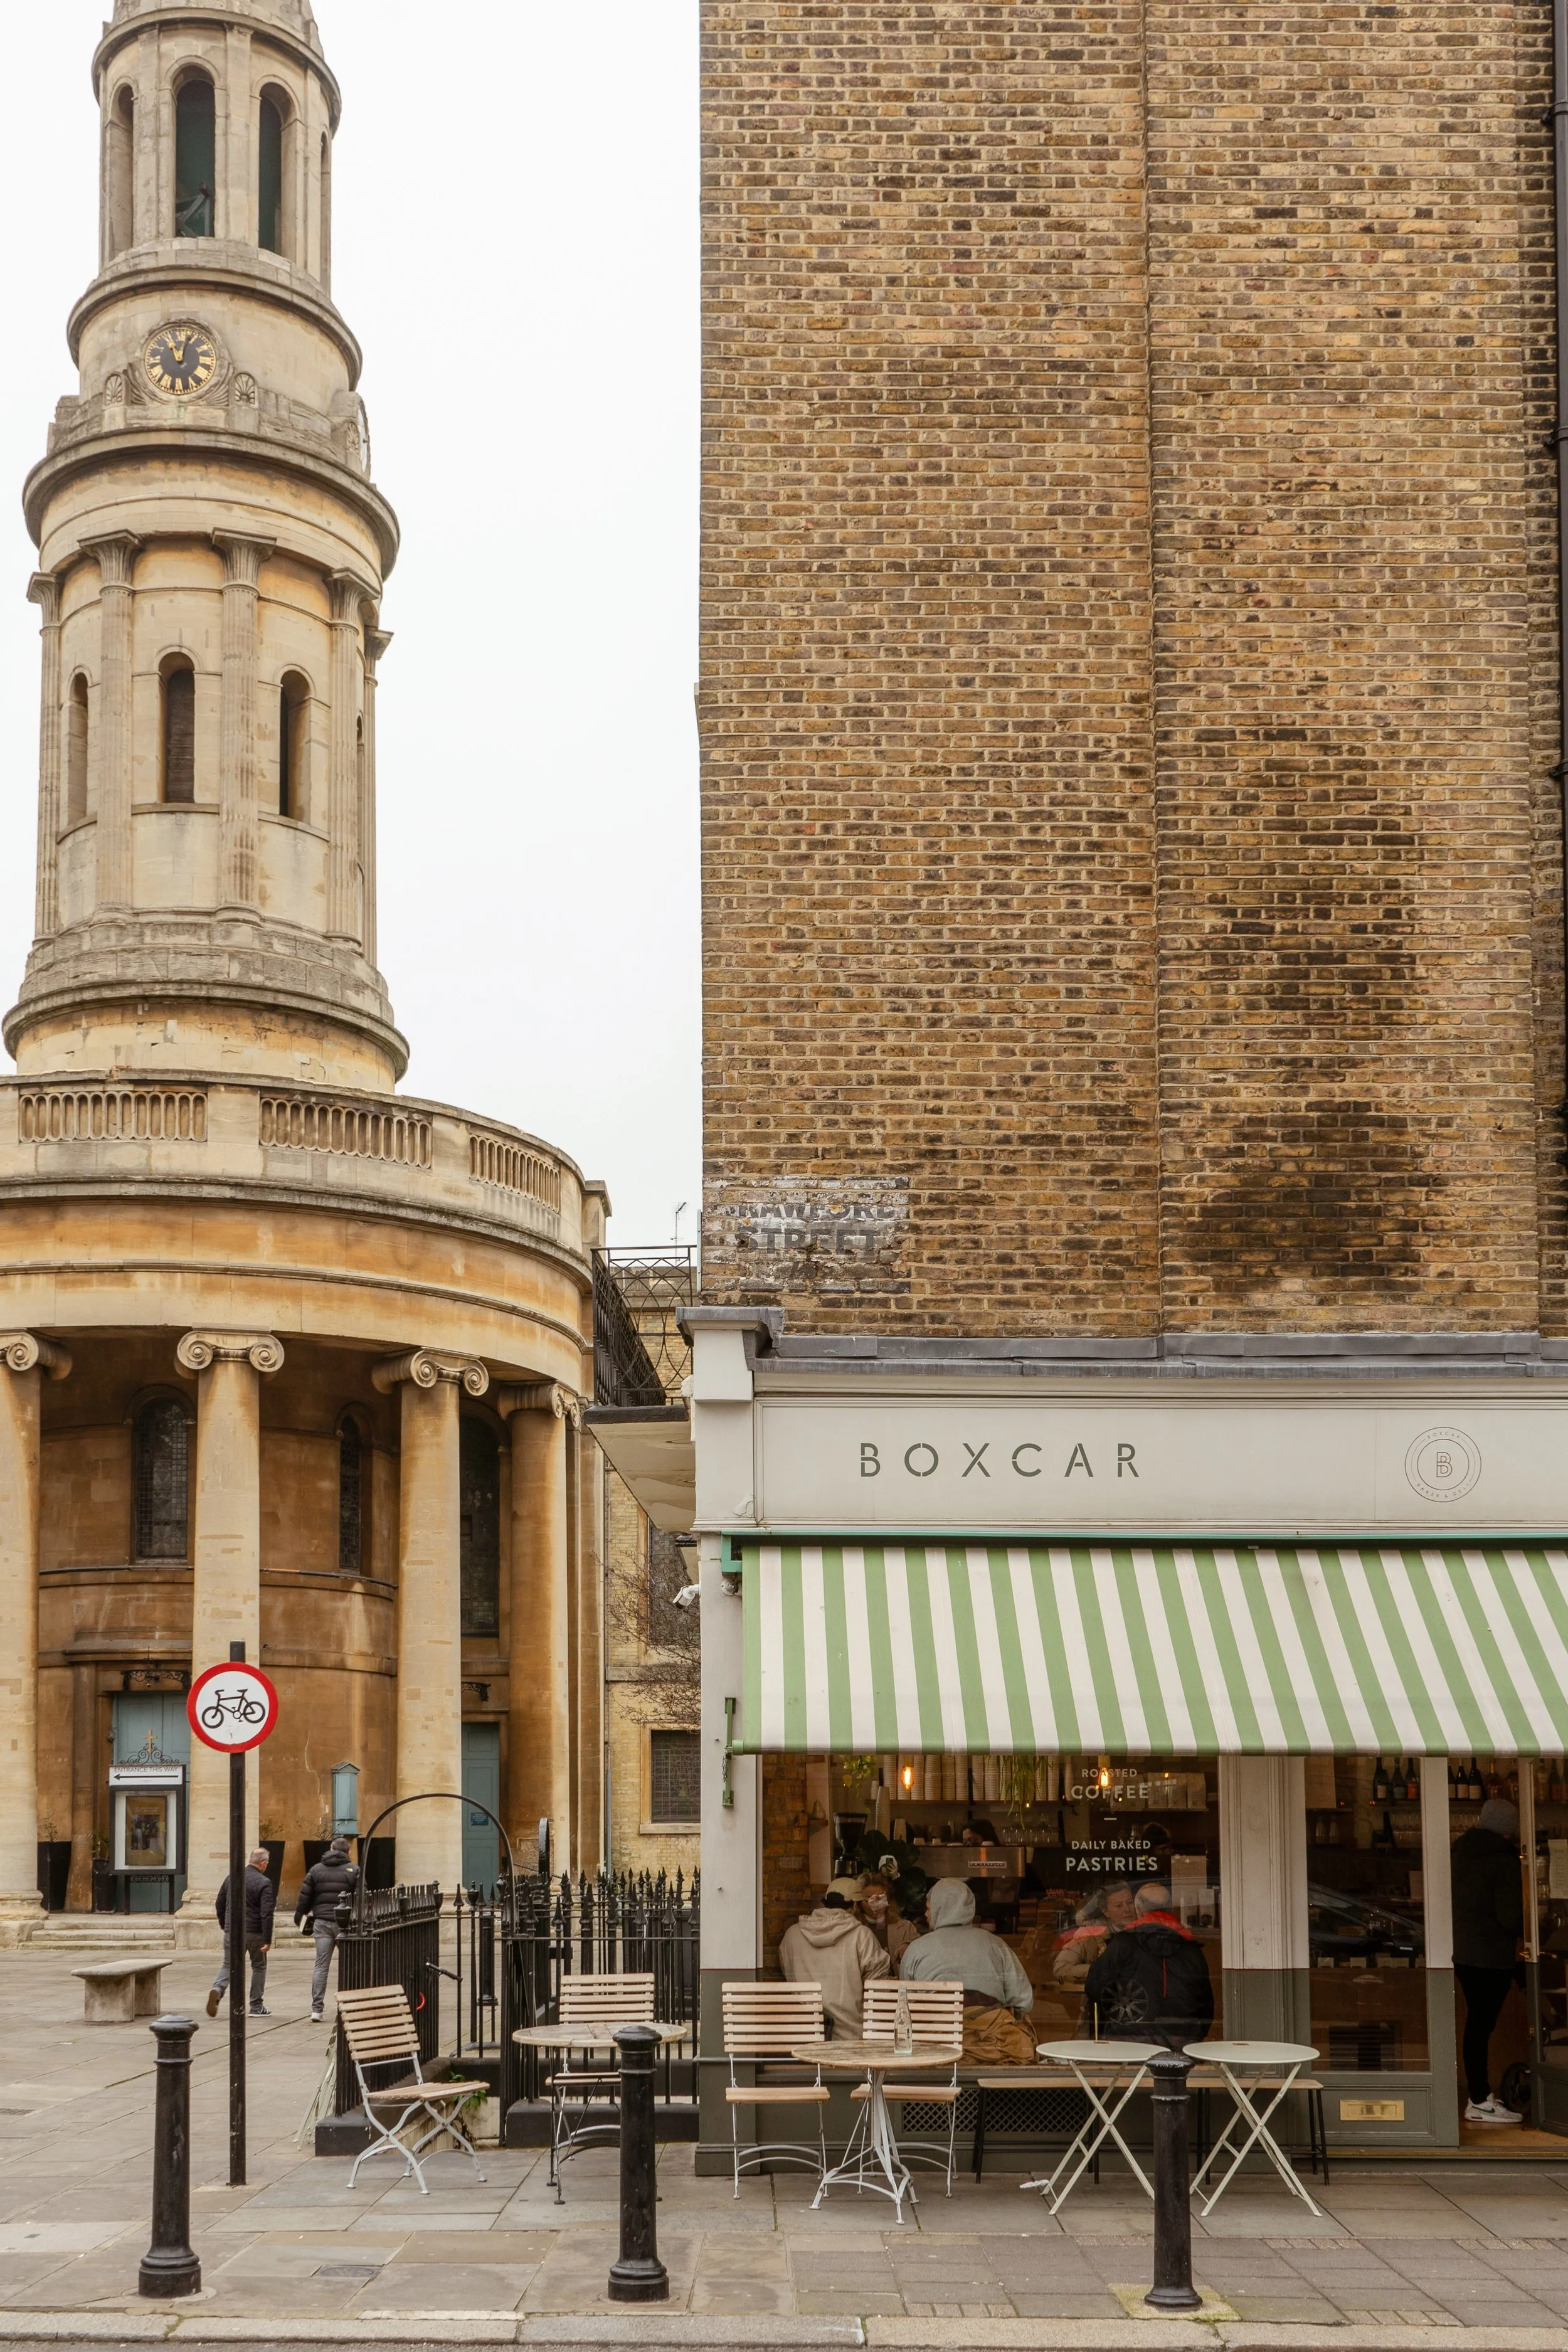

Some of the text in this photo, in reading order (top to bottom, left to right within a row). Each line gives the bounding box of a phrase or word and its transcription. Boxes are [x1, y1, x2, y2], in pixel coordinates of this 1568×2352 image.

[734, 1226, 881, 1254] STREET
[860, 1443, 1140, 1478] BOXCAR
[1436, 1451, 1453, 1477] B
[1082, 1769, 1137, 1777] ROASTED
[1071, 1785, 1148, 1799] COFFEE
[1071, 1840, 1151, 1850] DAILY BAKED
[1066, 1857, 1158, 1871] PASTRIES
